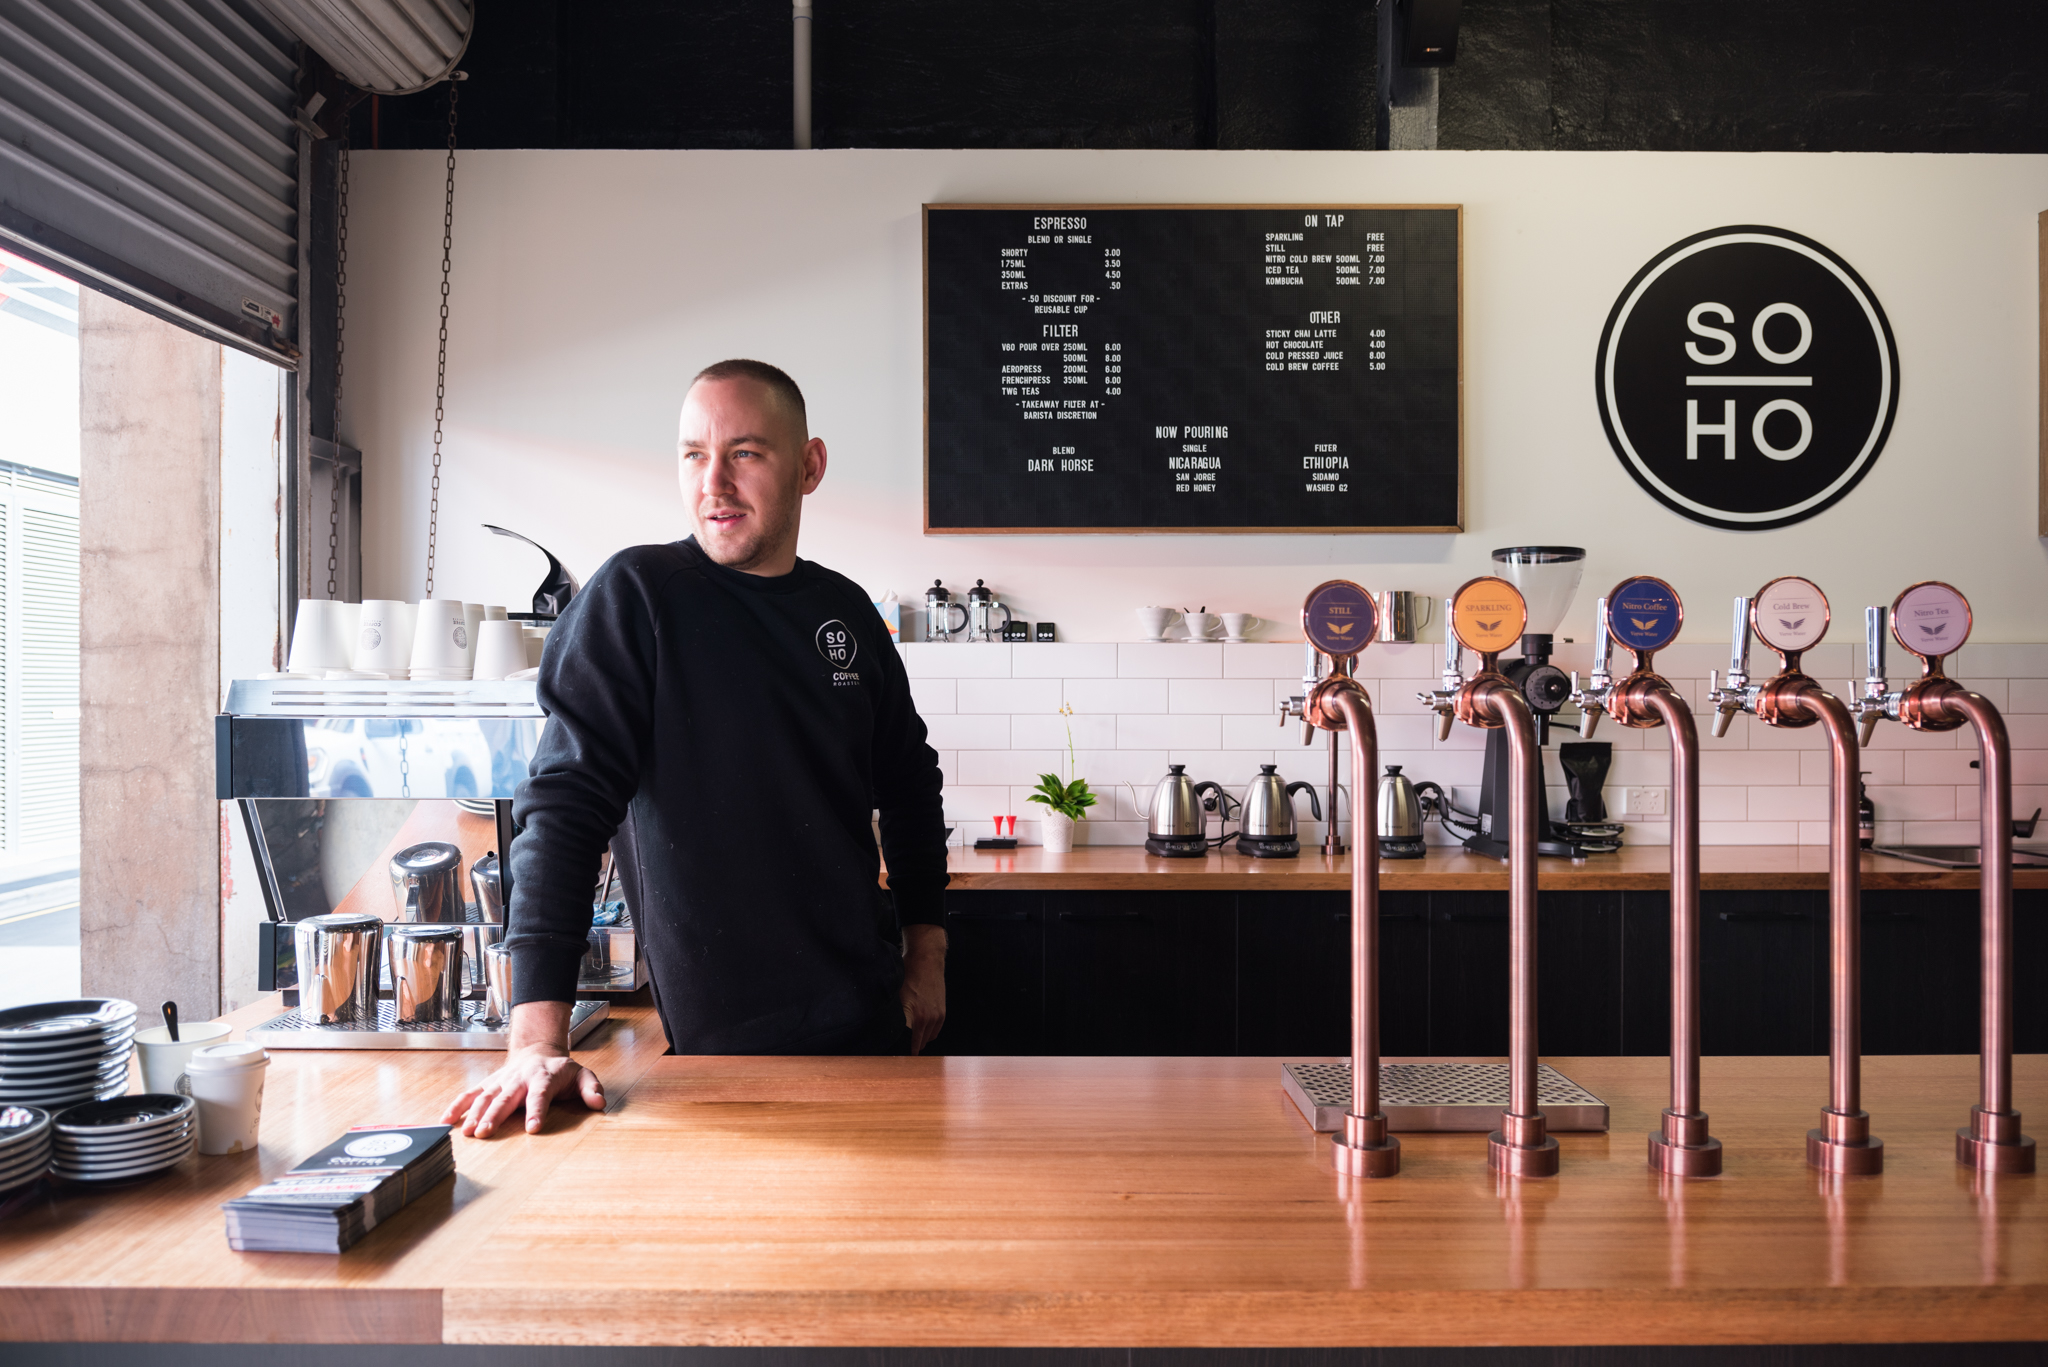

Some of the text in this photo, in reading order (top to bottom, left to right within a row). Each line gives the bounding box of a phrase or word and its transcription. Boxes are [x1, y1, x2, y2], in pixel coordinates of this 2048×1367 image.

[1035, 217, 1086, 229] ESPRESSO
[1305, 215, 1344, 227] ON TAP
[1266, 233, 1384, 241] SPARKLING FREE
[1266, 244, 1384, 252] STILL FREE
[1266, 255, 1385, 263] NITRO COLD BREW 500ML 7.00
[1266, 266, 1385, 274] ICED TEA 500ML 7.00
[1266, 277, 1385, 285] KOMBUCHA 500ML 7.00
[1310, 311, 1340, 323] OTHER
[1044, 325, 1078, 337] FILTER
[1266, 330, 1290, 338] STICKY
[1685, 302, 1813, 365] SO
[1002, 343, 1121, 351] V60 POUR OVER 250ML 6.00
[1266, 340, 1385, 349] HOT CHOCOLATE 4.00
[1064, 354, 1121, 362] 500ML 8.00
[1266, 352, 1284, 360] COLD
[1002, 365, 1121, 373] AEROPRESS 200ML 6.00
[1266, 363, 1284, 371] COLD
[1370, 362, 1385, 370] 5.00
[1002, 376, 1121, 384] FRENCHPRESS 350ML 6.00
[1002, 387, 1121, 395] TWG TEAS 4.00
[1022, 400, 1059, 408] TAKEAWAY
[1064, 400, 1086, 408] FILTER
[1057, 411, 1097, 419] DISCRETION
[1156, 426, 1228, 438] NOW POURING
[1686, 399, 1813, 461] HO
[1315, 444, 1337, 452] FILTER
[1028, 459, 1093, 471] DARK HORSE
[1169, 457, 1221, 469] NICARAGUA
[1304, 457, 1349, 469] ETHIOPIA
[1176, 473, 1215, 481] SAN JORGE
[1313, 473, 1339, 481] SIDAMO
[1176, 484, 1216, 492] RED HONEY
[1306, 484, 1335, 492] WASHED
[1465, 604, 1512, 612] SPARKLING
[1622, 602, 1667, 611] Nitro Coffee
[1329, 607, 1352, 615] STILL
[826, 631, 846, 643] SO
[829, 648, 846, 660] HO
